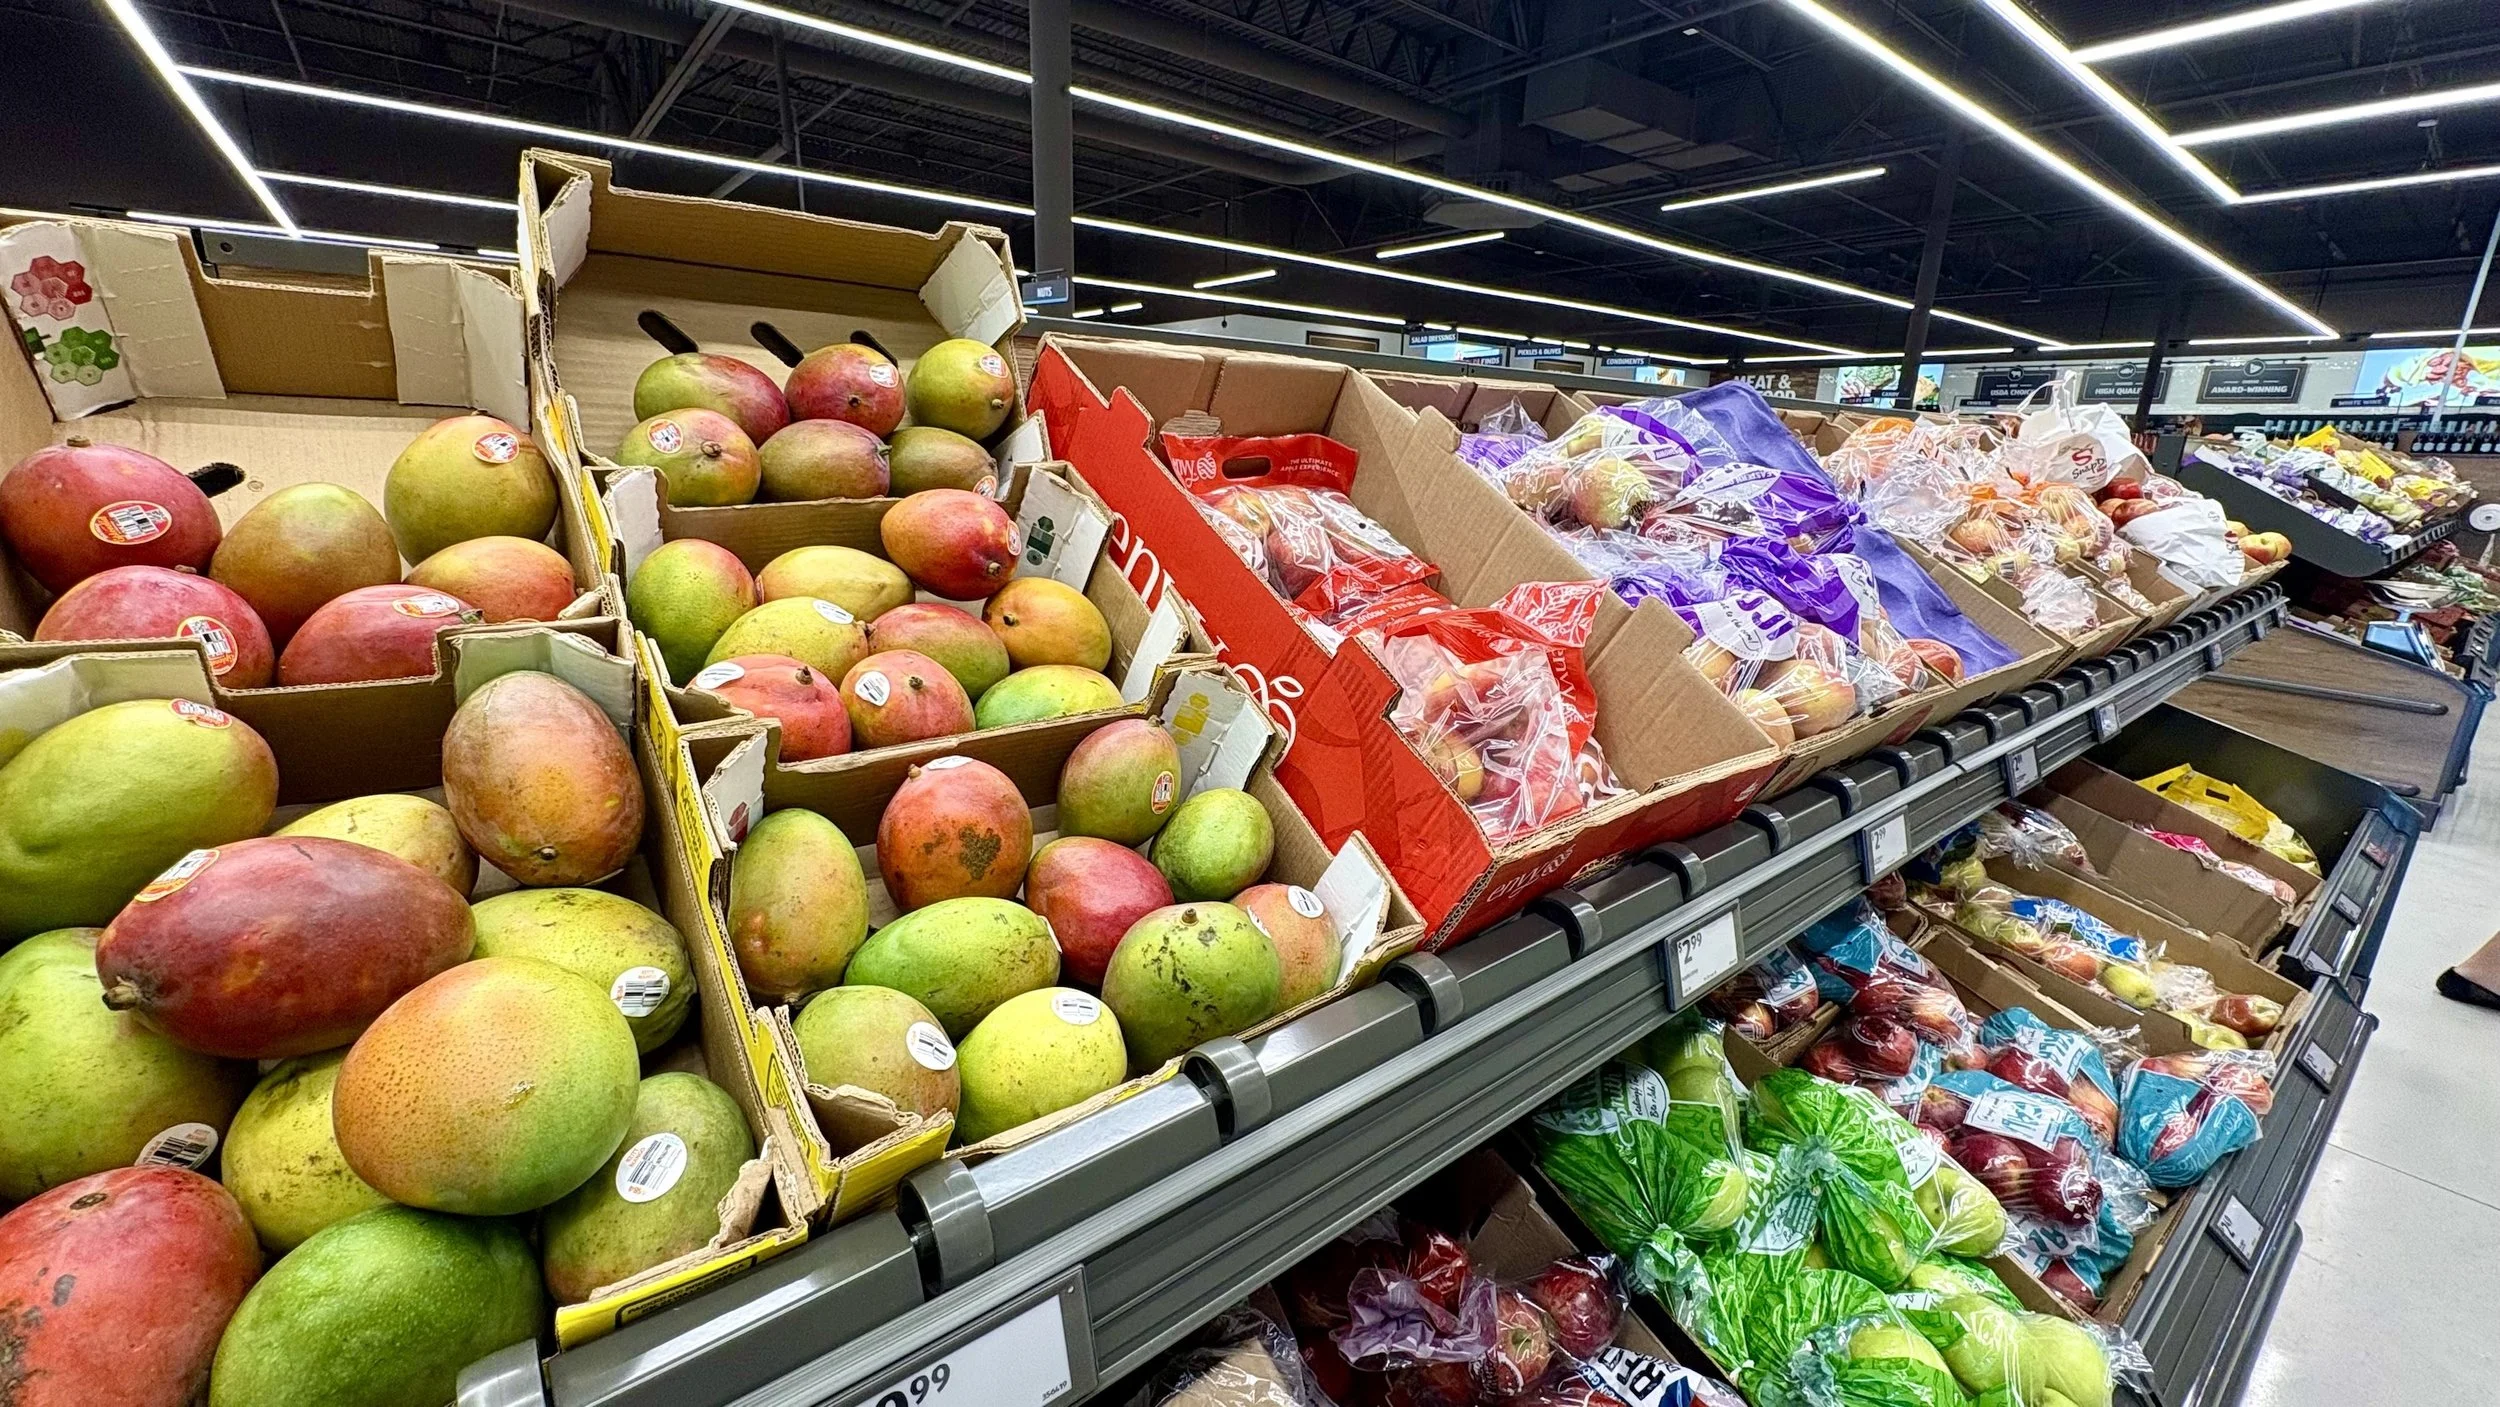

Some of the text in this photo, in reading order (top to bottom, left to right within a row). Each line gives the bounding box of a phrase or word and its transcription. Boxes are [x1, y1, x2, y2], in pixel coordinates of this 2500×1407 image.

[1037, 287, 1053, 298] NUTS
[1411, 333, 1456, 344] SALAD DRESSINGS
[1517, 348, 1538, 356] PICKLES
[1543, 347, 1562, 355] OLIVES
[1480, 356, 1500, 366] FINDS
[1606, 357, 1645, 366] CONDIMENTS
[1777, 373, 1792, 390] &
[2095, 387, 2115, 395] HIGH
[2210, 385, 2288, 395] AWARD-WINNING
[1300, 457, 1333, 468] ULTIMATE
[1280, 464, 1340, 478] APPLE EXPERIENCE
